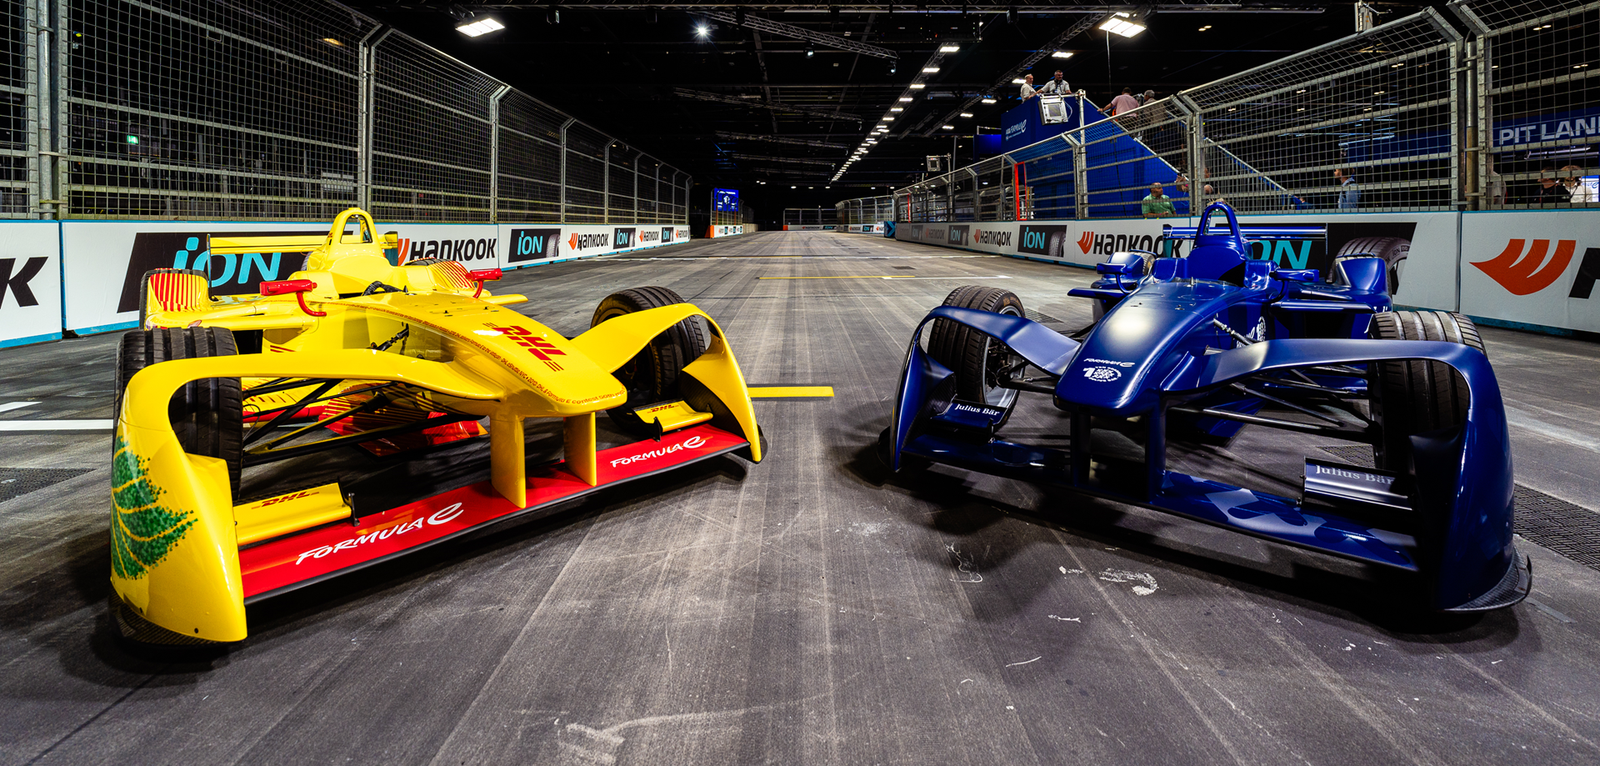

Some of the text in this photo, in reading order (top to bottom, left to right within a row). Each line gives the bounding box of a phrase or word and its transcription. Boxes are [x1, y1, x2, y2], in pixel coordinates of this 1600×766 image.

[1499, 116, 1600, 145] PIT LAN
[517, 231, 543, 255] iON
[1023, 227, 1045, 249] iON
[492, 326, 567, 361] DHL
[650, 404, 675, 412] DHL
[954, 403, 1000, 416] Julius Bär
[610, 443, 684, 468] FORMULA
[1315, 464, 1395, 485] Julius Bär
[261, 491, 310, 507] DHL
[295, 516, 425, 565] FORMULA
